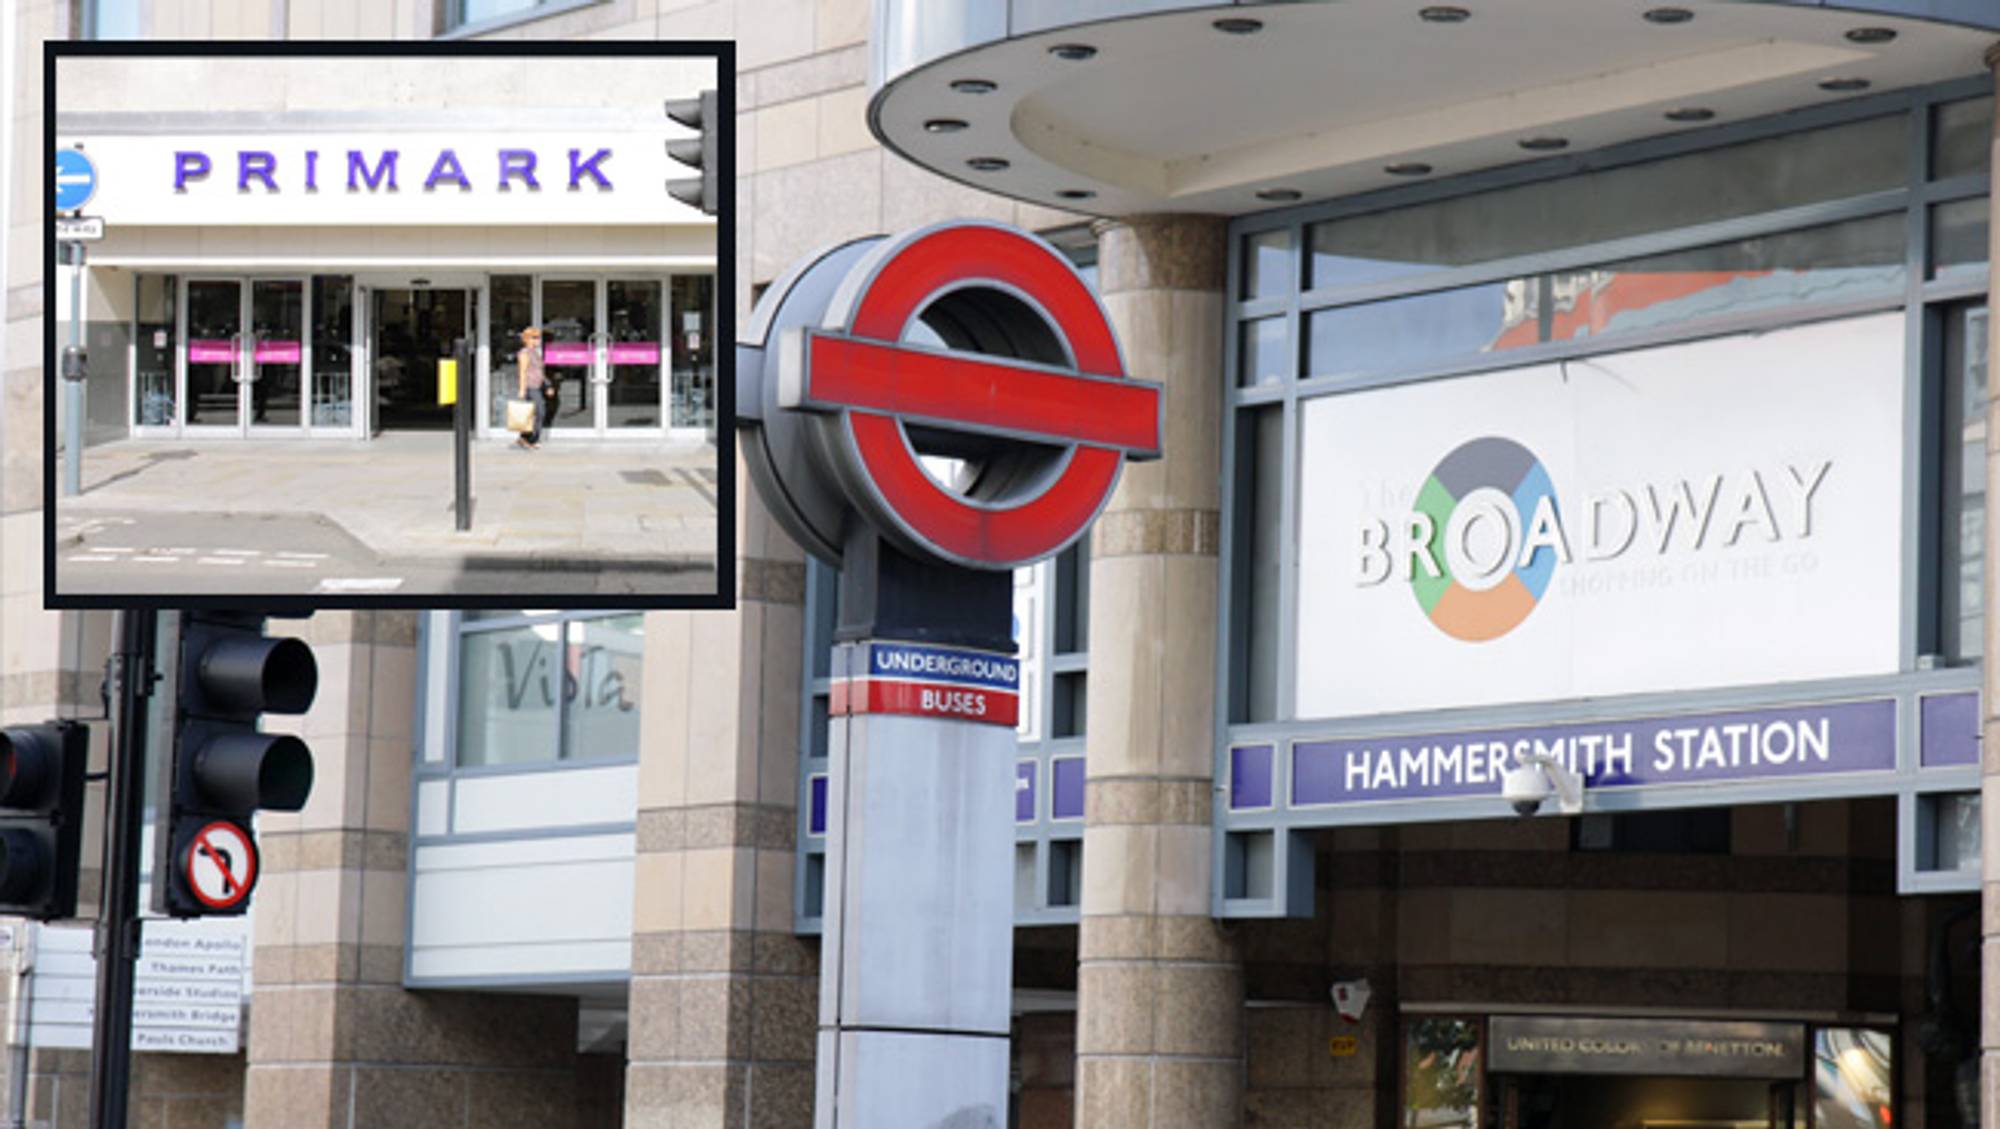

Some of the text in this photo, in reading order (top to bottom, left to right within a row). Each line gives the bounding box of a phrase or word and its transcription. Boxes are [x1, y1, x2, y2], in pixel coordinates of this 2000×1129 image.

[173, 148, 615, 194] PRIMARK
[1353, 460, 1833, 588] BROADWAY
[876, 652, 1017, 681] UNDERGROUND
[921, 689, 986, 715] BUSES
[1345, 719, 1830, 790] HAMMERSMITH STATION
[145, 937, 190, 948] ondon
